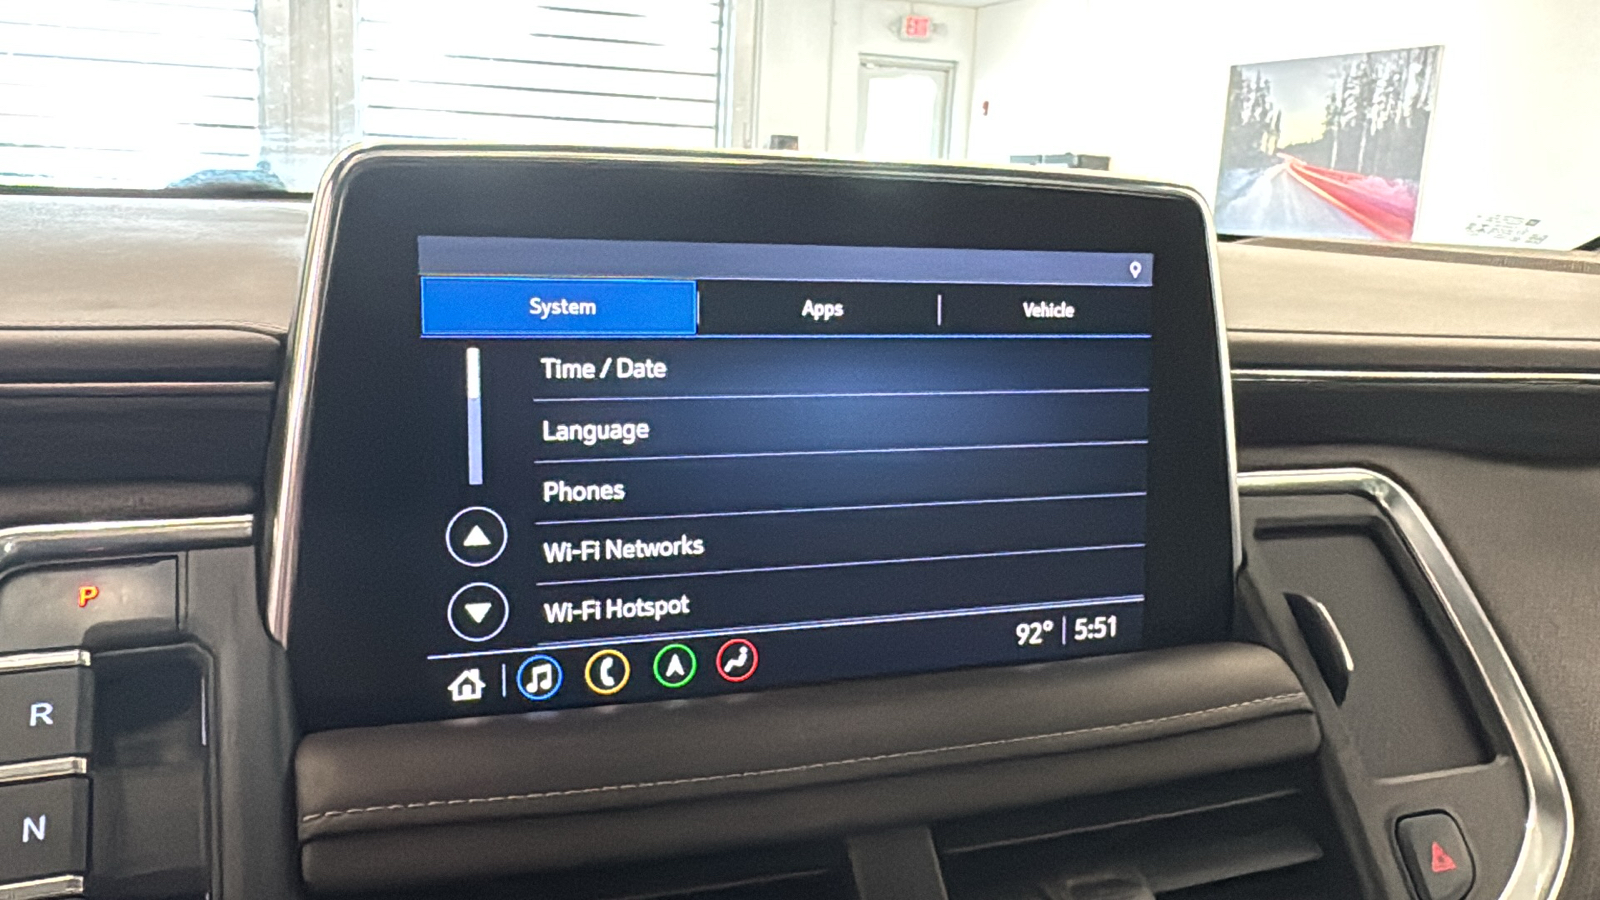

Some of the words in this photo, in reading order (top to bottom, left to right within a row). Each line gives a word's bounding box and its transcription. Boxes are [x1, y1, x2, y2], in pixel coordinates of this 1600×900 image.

[529, 297, 597, 320] System
[801, 299, 844, 321] Apps
[1022, 300, 1076, 319] Vehicle
[540, 357, 596, 379] Time
[599, 357, 613, 379] /
[616, 357, 668, 379] Date
[542, 420, 650, 446] Language
[543, 480, 626, 503] Phones
[543, 540, 601, 564] Wi-Fi
[605, 533, 705, 561] Networks
[78, 585, 99, 607] P
[543, 599, 601, 624] Wi-Fi
[605, 594, 691, 621] Hotspot
[1074, 614, 1117, 641] 5:51
[29, 702, 54, 727] R
[22, 814, 46, 843] N
